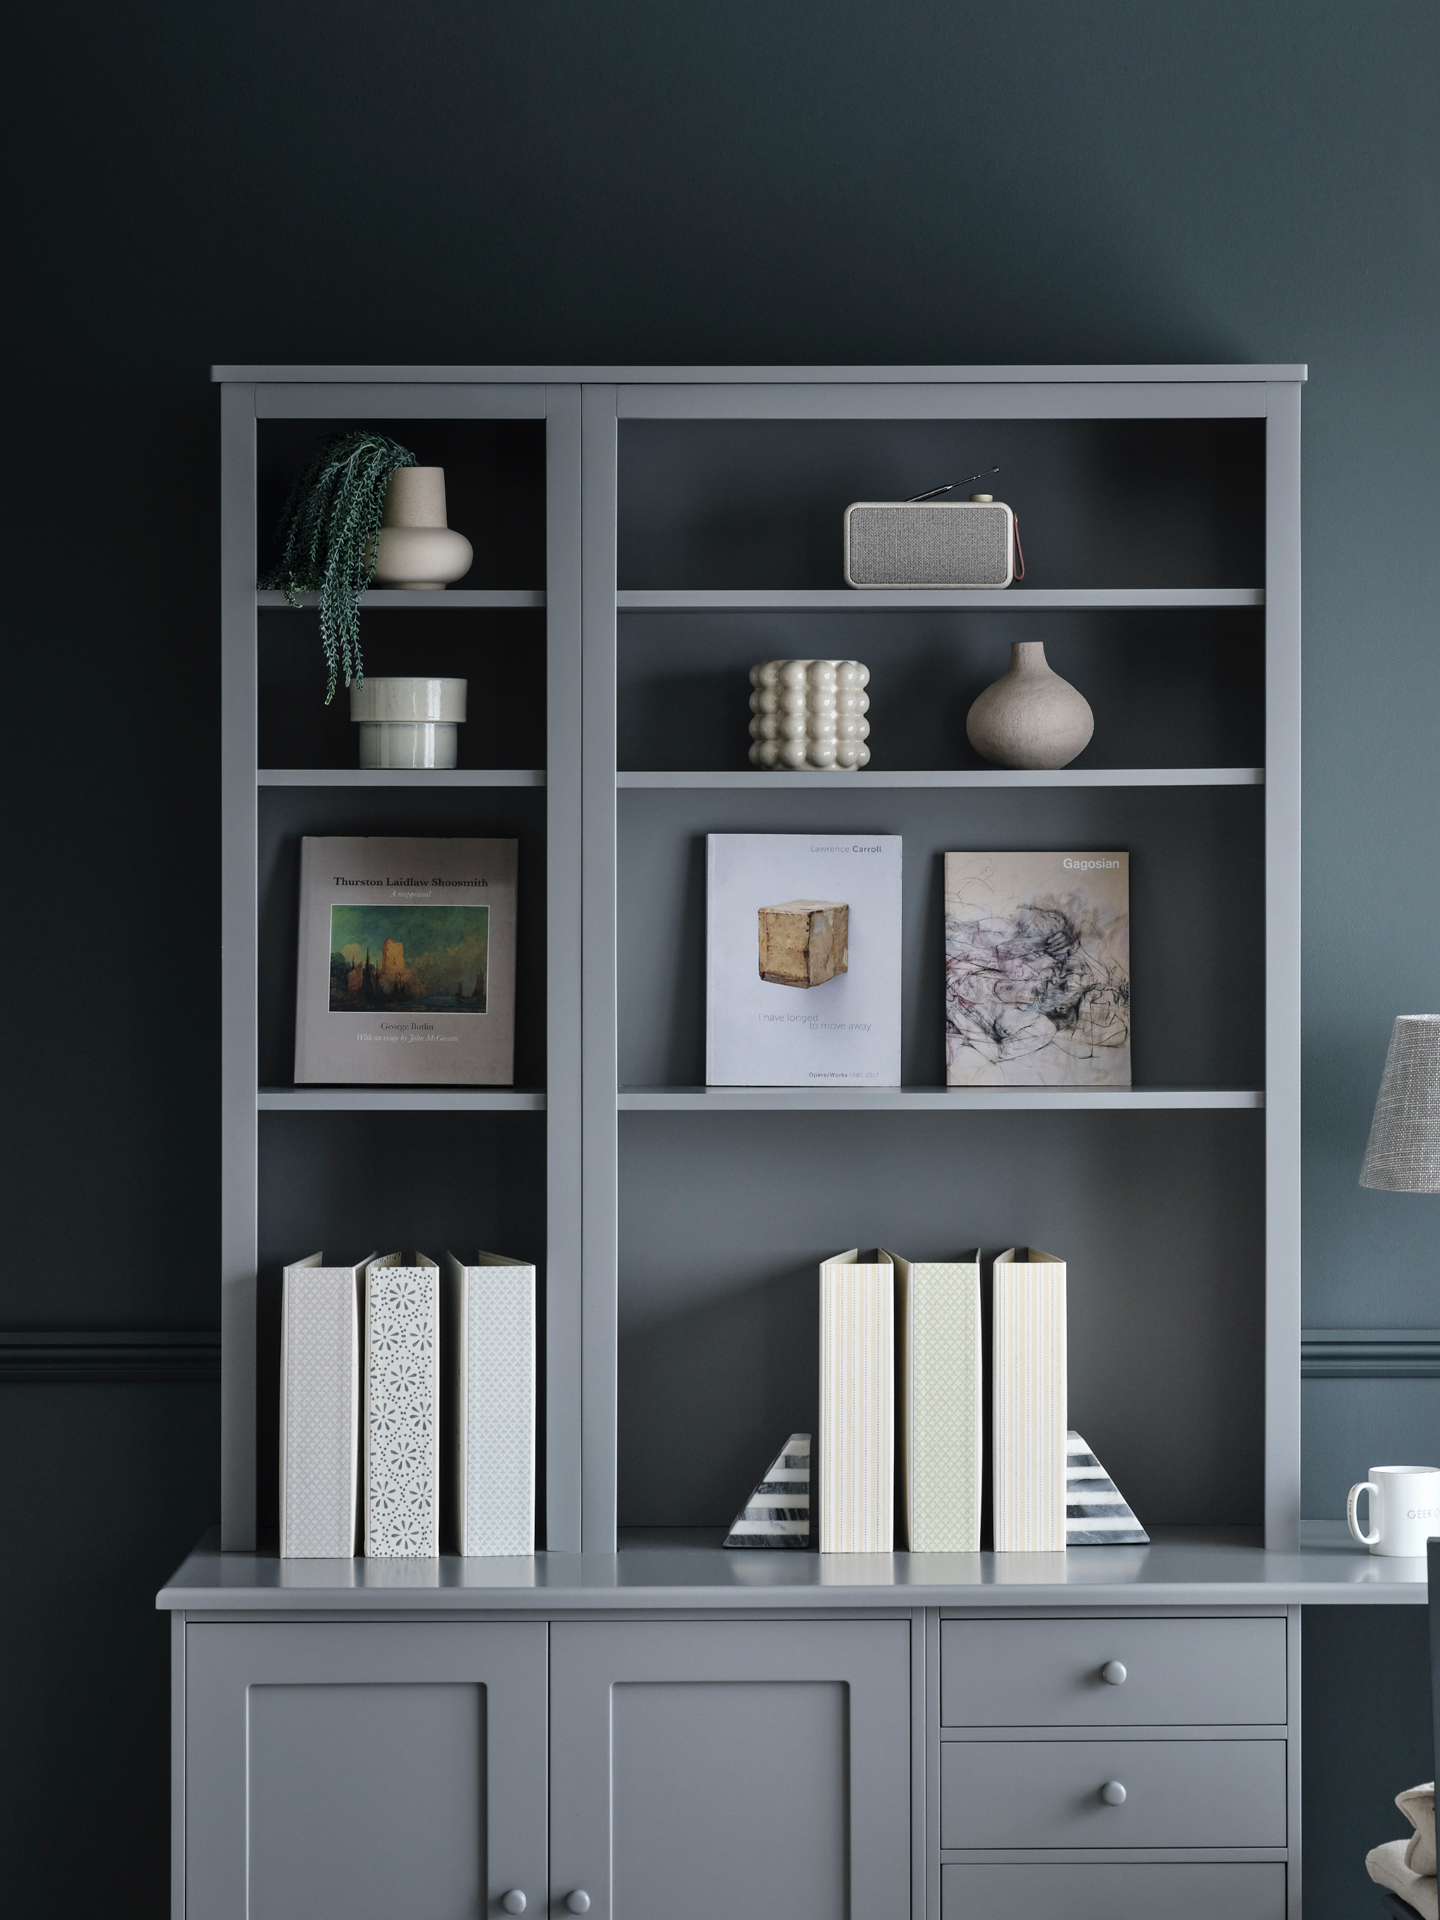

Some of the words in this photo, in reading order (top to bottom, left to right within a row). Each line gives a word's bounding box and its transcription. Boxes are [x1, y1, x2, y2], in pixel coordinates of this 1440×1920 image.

[810, 845, 850, 853] Lawrence
[852, 845, 882, 853] Carroll
[1063, 858, 1120, 871] Gagosian
[333, 876, 383, 886] Thurston
[386, 877, 429, 887] Laidlaw
[431, 877, 489, 887] Shoosmith
[397, 891, 432, 899] reappraisal
[787, 1014, 819, 1024] longed
[380, 1022, 409, 1032] George
[411, 1022, 434, 1030] Butlin
[809, 1022, 819, 1030] to
[848, 1023, 872, 1032] away
[356, 1033, 373, 1041] With
[383, 1035, 400, 1044] essay
[400, 1034, 407, 1043] by
[407, 1034, 424, 1043] John
[1407, 1509, 1433, 1519] GEEK
